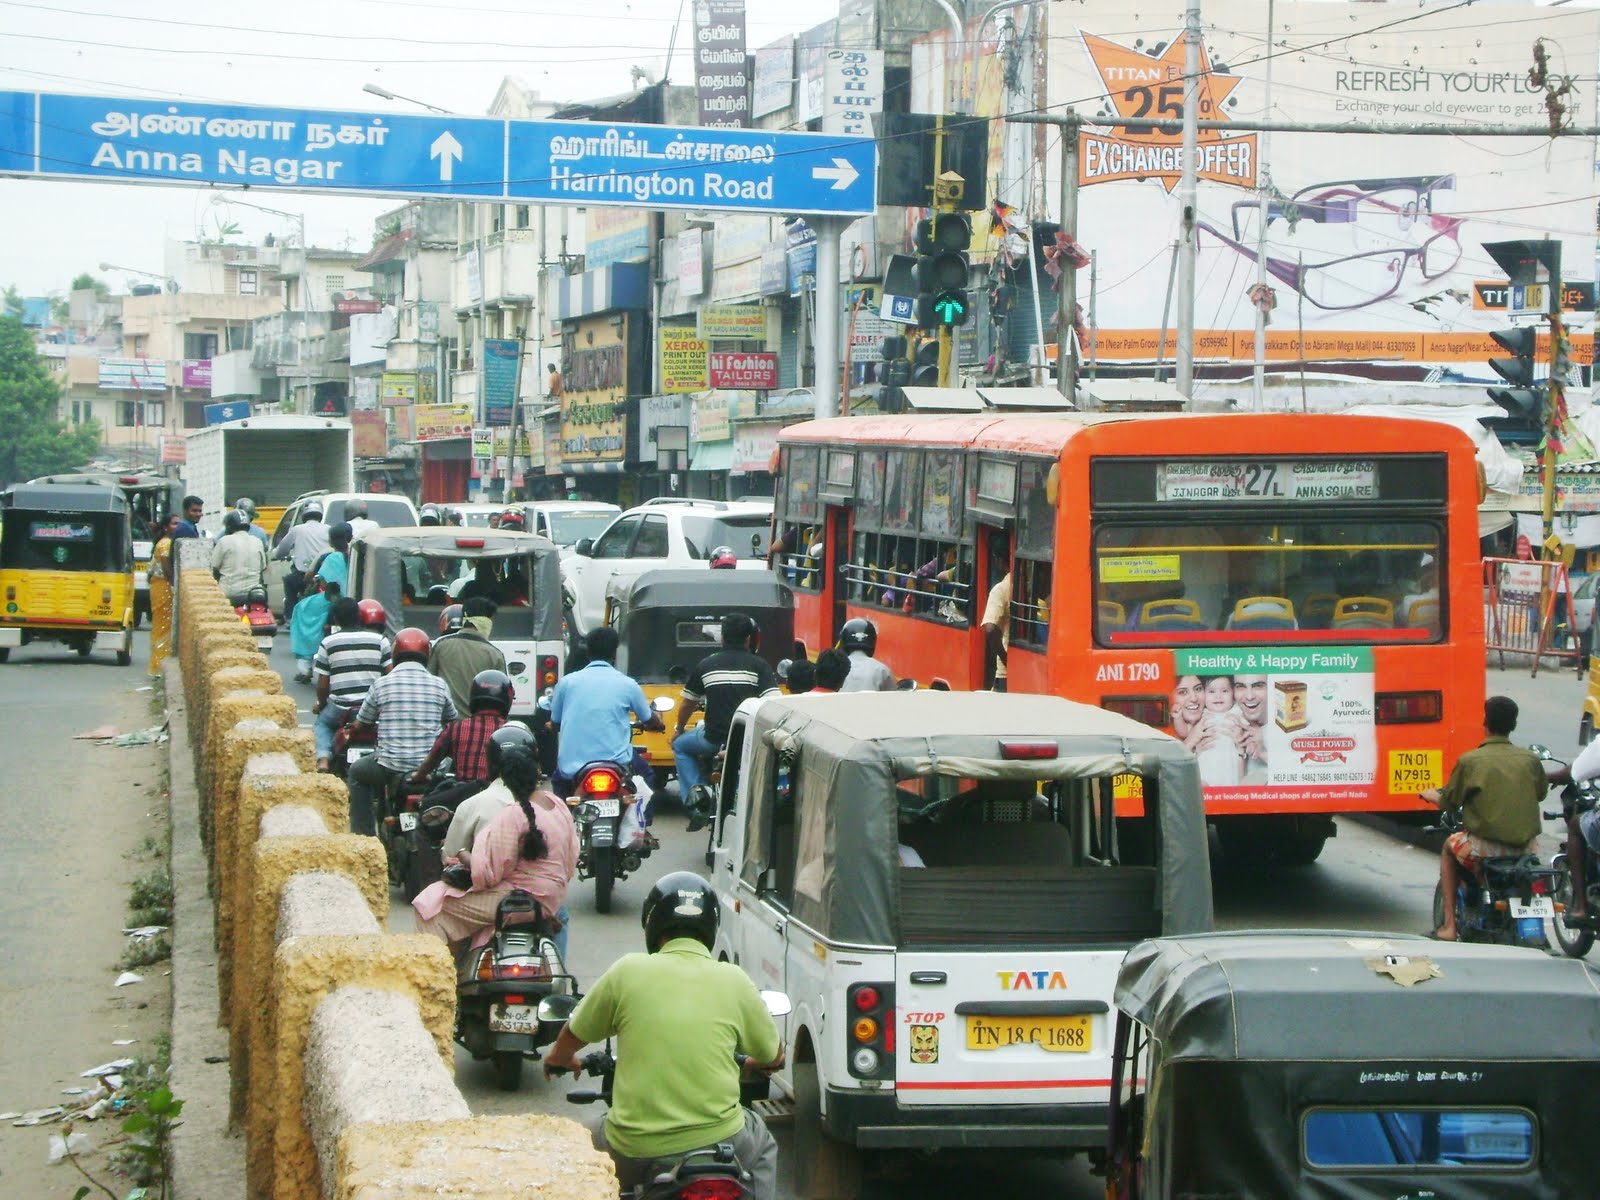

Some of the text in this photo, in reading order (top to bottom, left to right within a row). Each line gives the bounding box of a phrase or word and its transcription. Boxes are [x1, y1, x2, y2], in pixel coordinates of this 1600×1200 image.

[1105, 67, 1160, 81] TITAN
[699, 72, 746, 91] தையல்
[1335, 70, 1430, 91] REFRESH
[1441, 73, 1506, 93] YOUR
[1335, 99, 1390, 114] Exchange
[1392, 103, 1419, 116] your
[1424, 101, 1442, 112] old
[1446, 104, 1495, 117] eyewear
[1498, 103, 1511, 113] to
[1515, 103, 1533, 115] get
[91, 107, 390, 152] அண்ணா நகர்
[91, 142, 343, 183] Anna Nagar
[1085, 138, 1251, 179] EXCHANGE OFFER
[550, 166, 774, 200] Harrington Road
[1526, 288, 1541, 307] LIC
[665, 341, 705, 351] XEROX
[1124, 339, 1139, 349] Palm
[1140, 338, 1160, 349] Groov
[1304, 341, 1311, 350] to
[1312, 340, 1336, 351] Abirami
[1337, 340, 1354, 352] Mega
[1430, 343, 1447, 352] Anna
[663, 351, 706, 359] PRINT OUT
[711, 355, 723, 370] hi
[715, 370, 771, 380] TAILORS
[1245, 463, 1285, 497] 27L
[1295, 485, 1372, 498] ANNA SQUARE
[1188, 652, 1359, 670] Healthy & Happy Family
[1128, 663, 1160, 681] 1790
[1341, 700, 1362, 708] 100%
[1332, 709, 1371, 717] Ayurvedic
[1293, 740, 1354, 748] MUSLI POWER
[1398, 753, 1428, 766] TN 01
[1274, 773, 1286, 781] HELP
[1287, 773, 1298, 781] LINE
[1214, 792, 1222, 800] at
[1223, 792, 1249, 801] leading
[1250, 791, 1278, 800] Medical
[1279, 791, 1300, 801] shops
[1301, 791, 1310, 799] all
[1329, 790, 1347, 799] Tamil
[1348, 790, 1368, 798] Nadu
[996, 971, 1067, 990] TATA
[904, 1012, 946, 1024] STOP
[973, 1026, 1001, 1045] TN
[1007, 1027, 1025, 1046] 18
[1047, 1028, 1085, 1047] 1688
